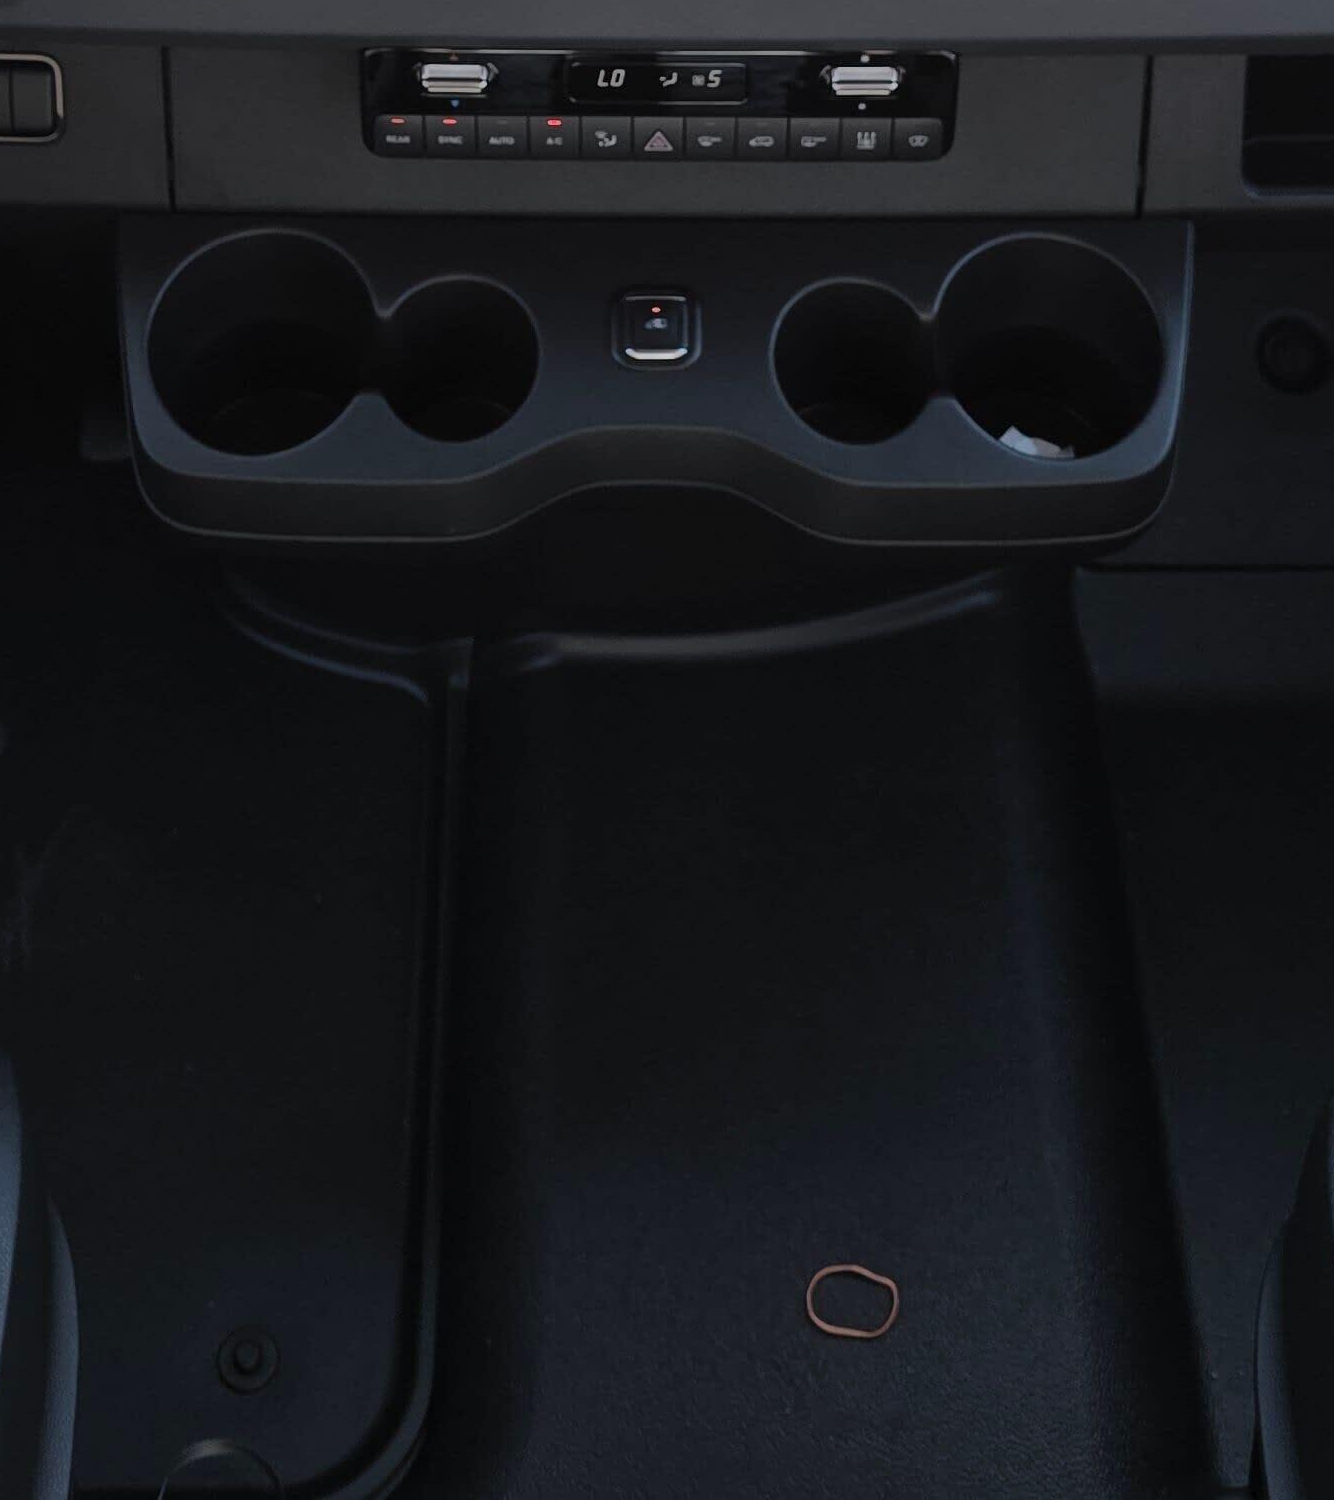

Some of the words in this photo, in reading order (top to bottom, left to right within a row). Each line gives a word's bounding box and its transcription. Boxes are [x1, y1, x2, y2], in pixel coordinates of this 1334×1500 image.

[597, 68, 626, 88] LO
[385, 133, 411, 145] REAR
[437, 134, 463, 145] SYNC
[488, 135, 515, 146] AUTO
